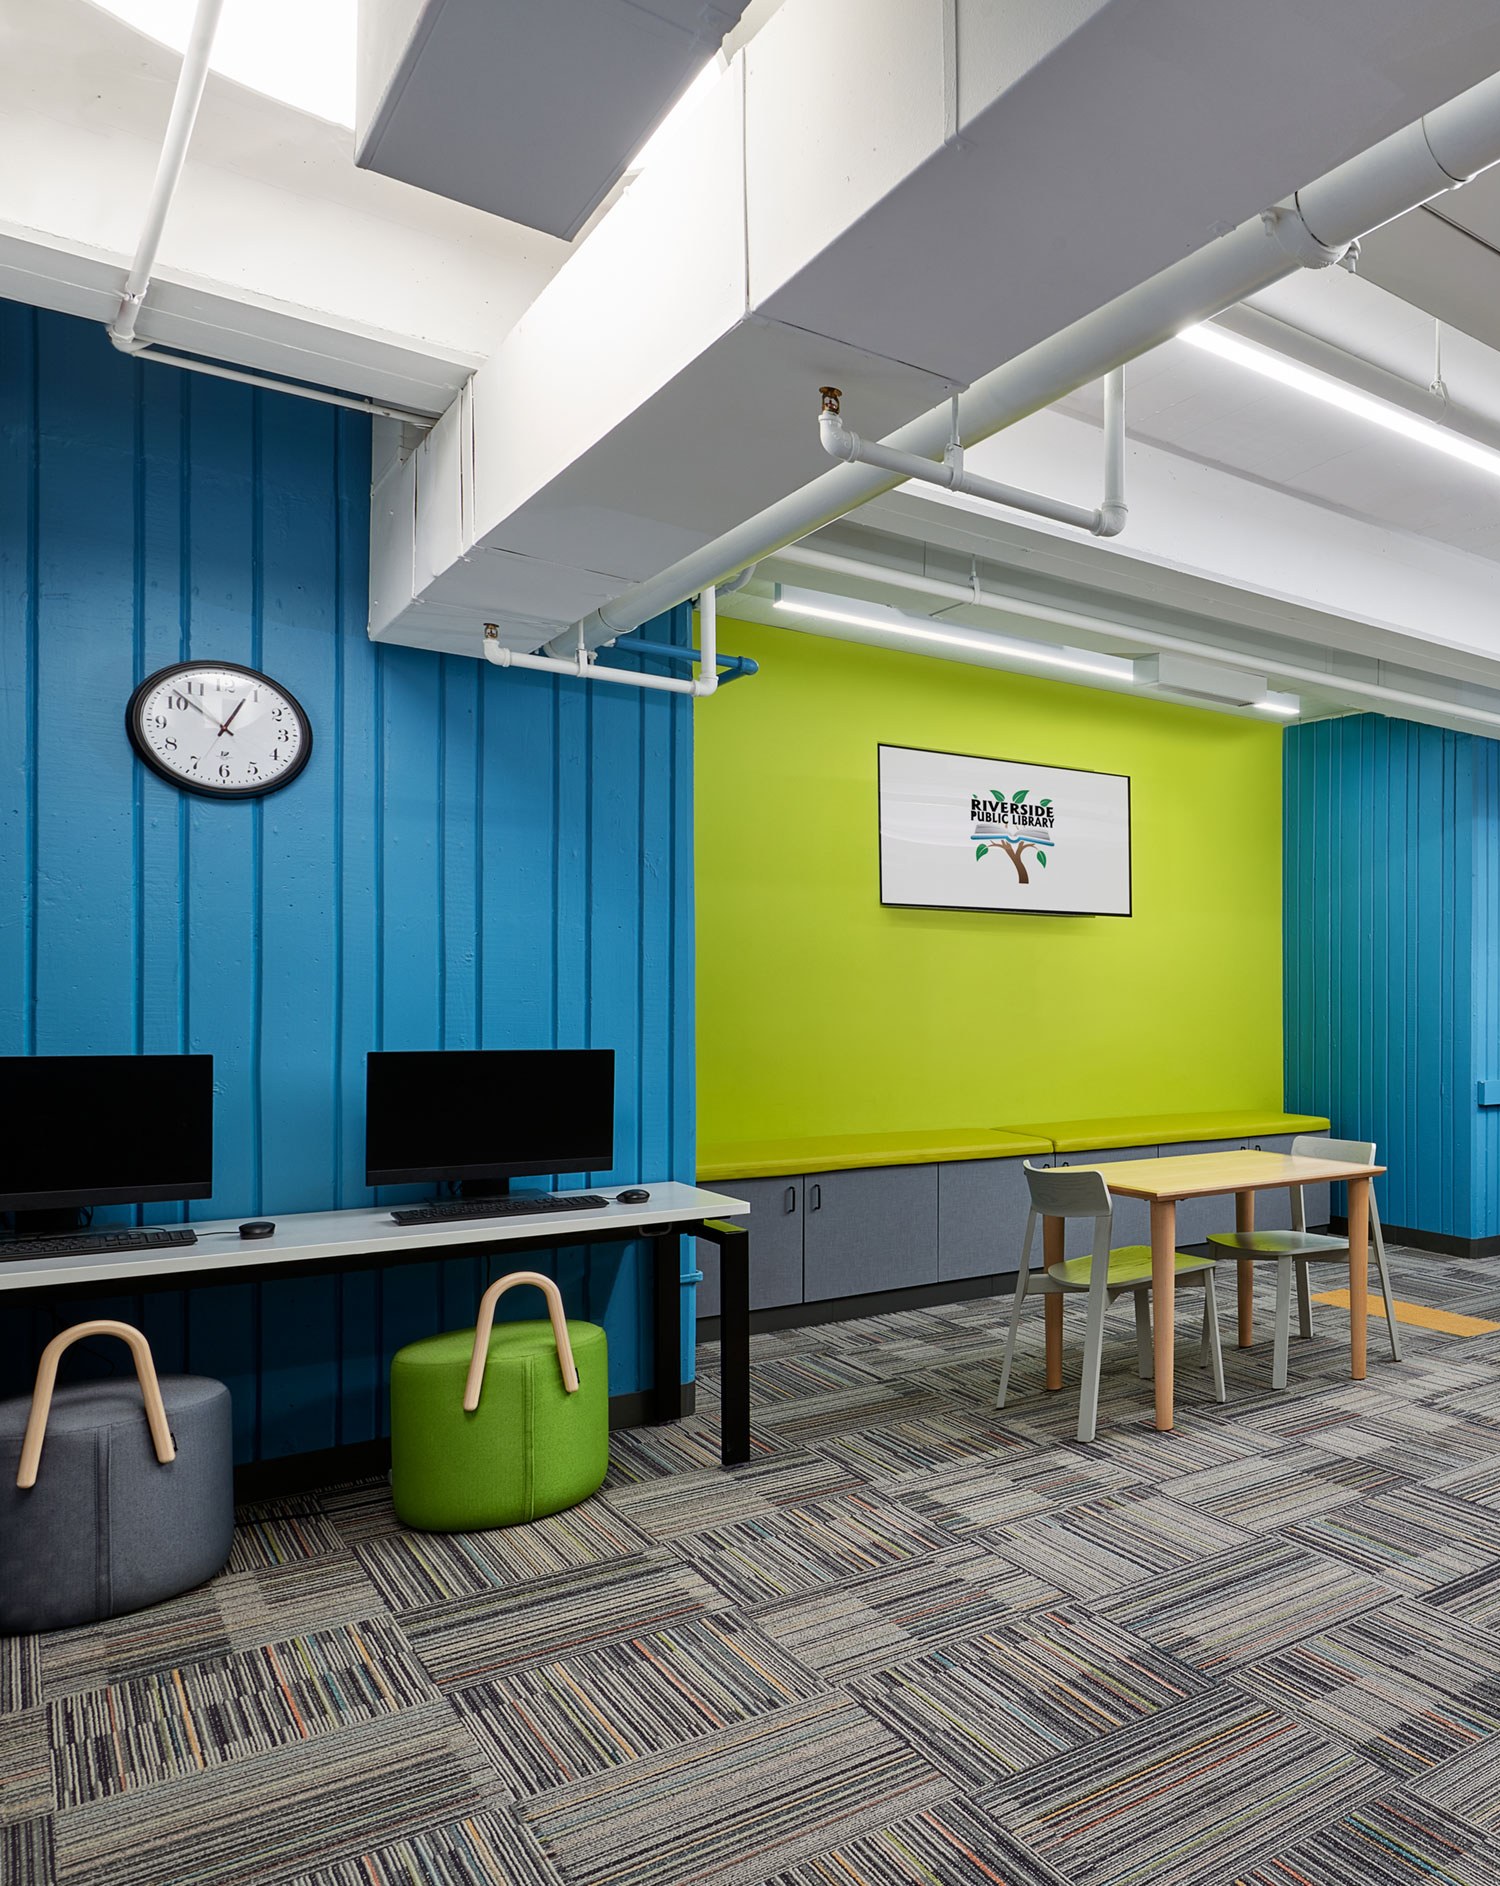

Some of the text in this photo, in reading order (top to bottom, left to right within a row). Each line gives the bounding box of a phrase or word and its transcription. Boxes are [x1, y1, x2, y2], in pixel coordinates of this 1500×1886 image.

[187, 681, 204, 696] 11
[215, 678, 235, 693] 12
[167, 695, 189, 711] 10
[253, 689, 259, 703] 1
[155, 715, 167, 729] 9
[272, 708, 282, 722] 2
[278, 729, 289, 742] 3
[165, 737, 177, 751] 8
[269, 748, 280, 761] 4
[190, 756, 200, 770] 7
[248, 761, 258, 775] 5
[219, 764, 230, 778] 6
[971, 799, 1054, 818] RIVERSIDE
[971, 811, 1055, 828] PUBLIC LIBRARY
